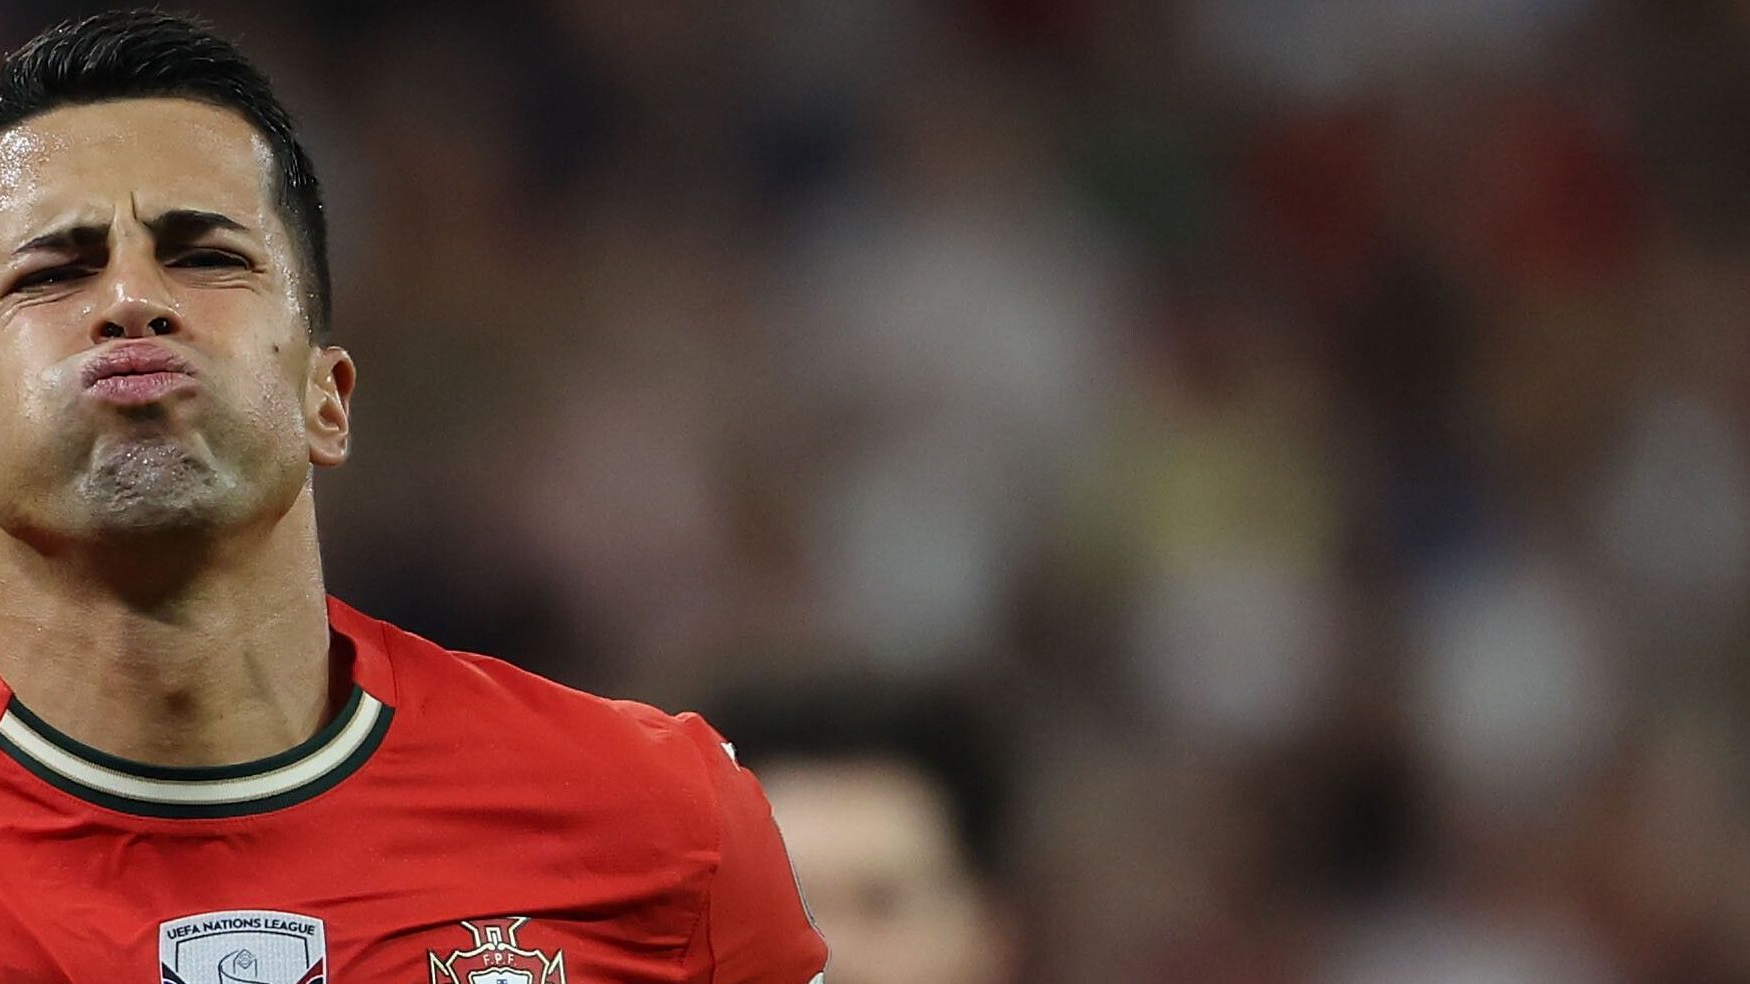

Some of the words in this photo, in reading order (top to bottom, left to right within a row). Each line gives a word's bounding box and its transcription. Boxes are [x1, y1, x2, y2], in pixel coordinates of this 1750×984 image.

[166, 924, 200, 940] UEFA
[203, 918, 261, 932] NATIONS
[264, 918, 316, 936] LEAGUE
